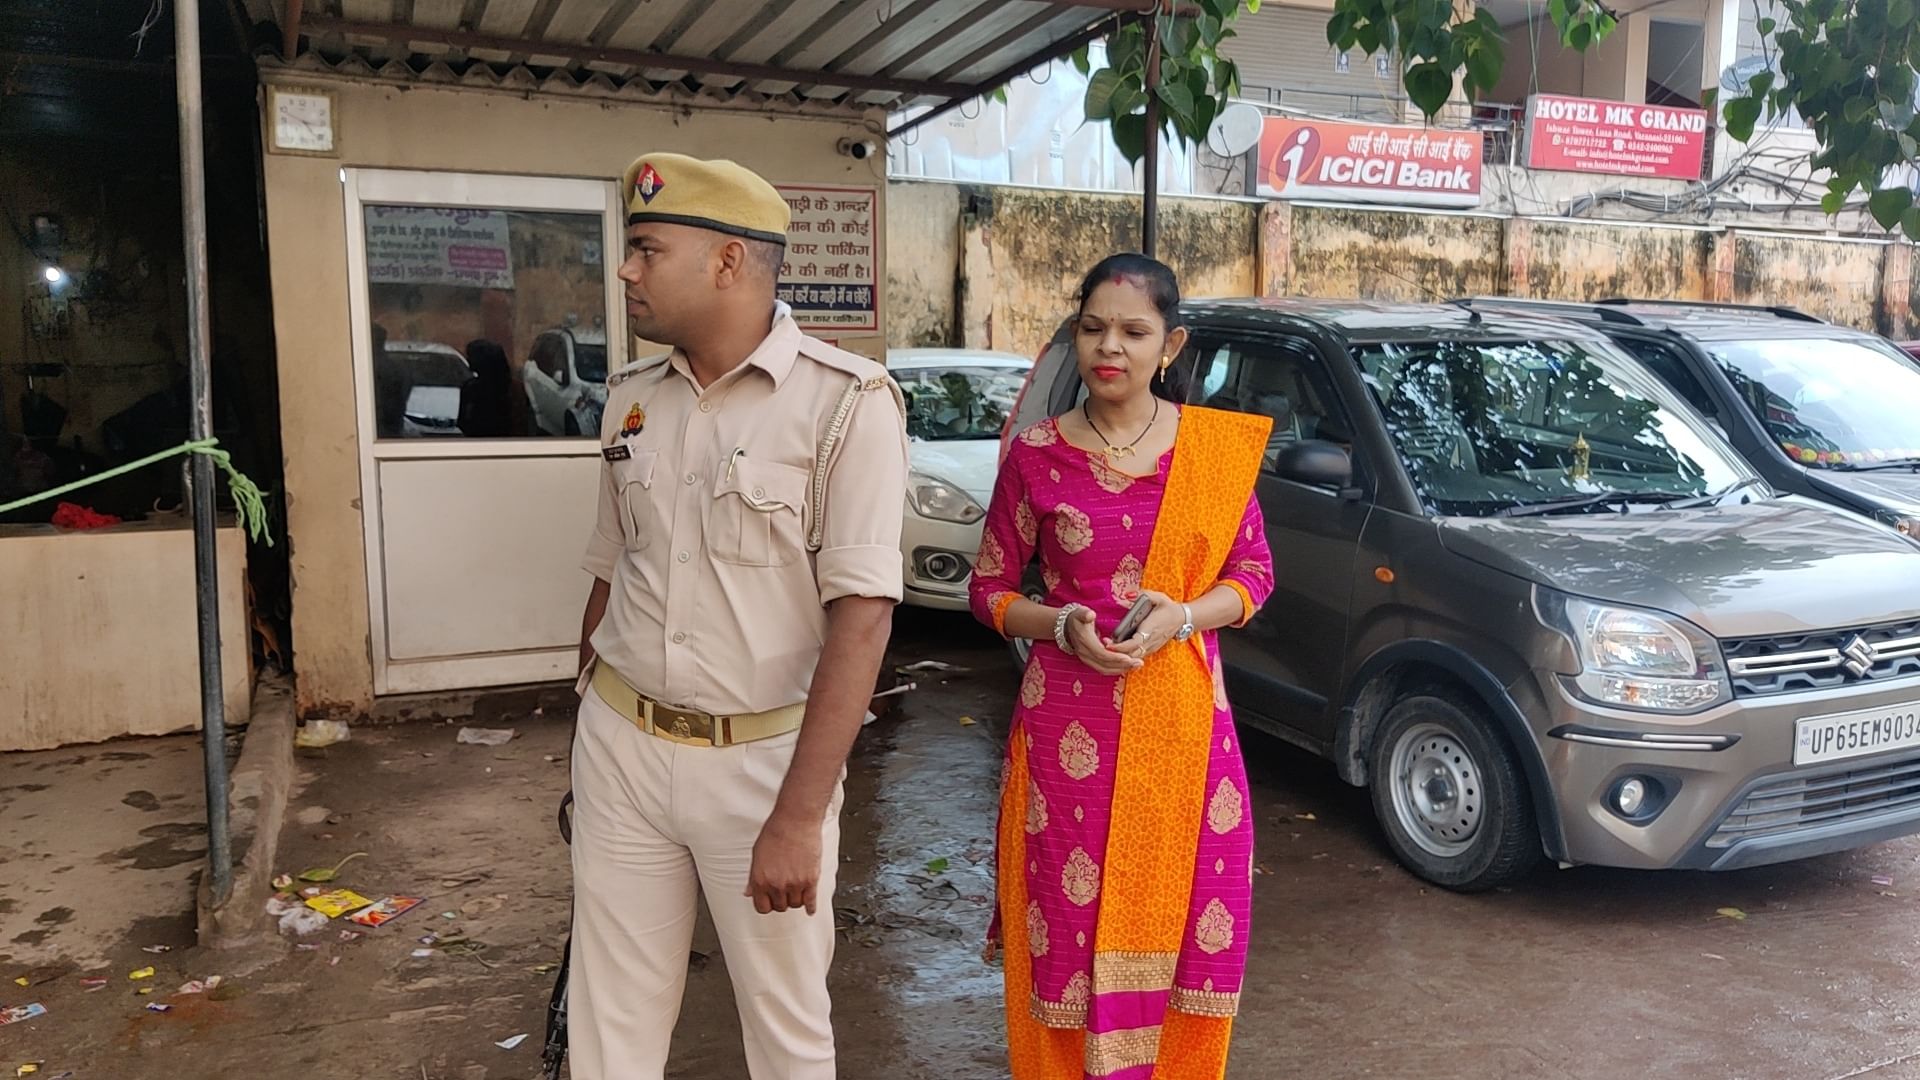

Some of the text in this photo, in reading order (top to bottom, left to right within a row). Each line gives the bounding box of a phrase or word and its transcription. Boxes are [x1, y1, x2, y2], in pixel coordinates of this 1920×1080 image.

[1535, 99, 1706, 133] HOTEL MK GRAND
[1319, 156, 1473, 190] ICICI Bank
[815, 197, 829, 211] के
[833, 200, 870, 213] अन्दर
[817, 218, 836, 233] की
[841, 220, 870, 236] कोई
[791, 241, 870, 256] कार पार्किंग
[799, 262, 817, 277] की
[824, 263, 849, 278] नहीं
